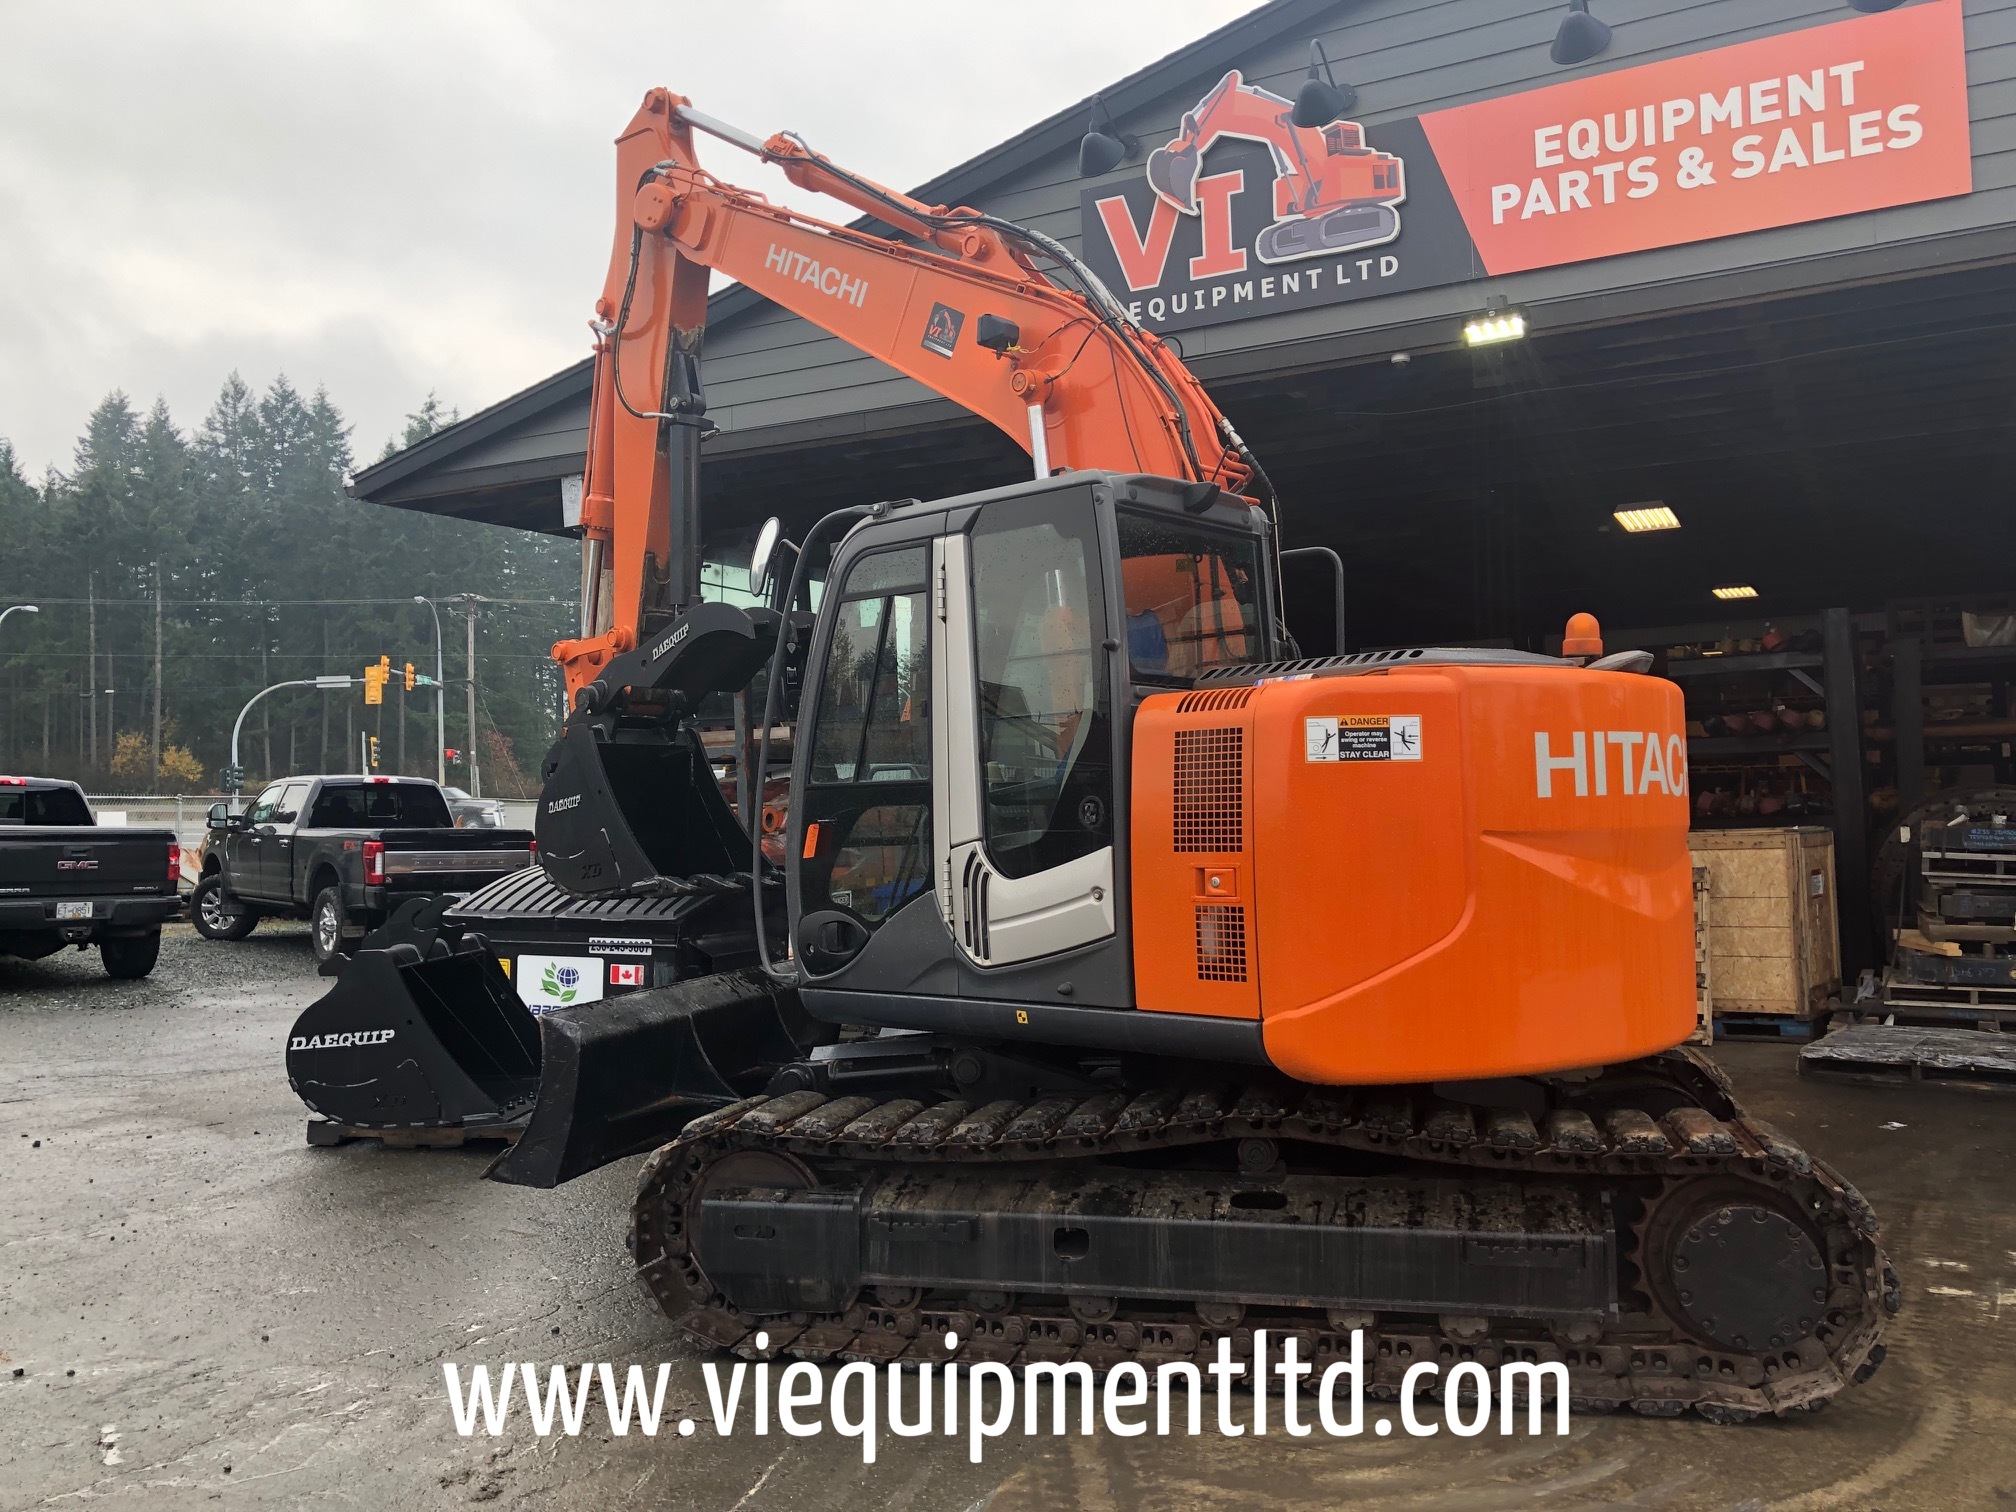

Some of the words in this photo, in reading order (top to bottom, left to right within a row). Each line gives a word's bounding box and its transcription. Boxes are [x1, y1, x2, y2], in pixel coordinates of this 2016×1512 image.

[1534, 60, 1865, 168] EQUIPMENT
[1491, 156, 1660, 226] PARTS
[1676, 146, 1718, 189] &
[1731, 103, 1923, 180] SALES
[1095, 169, 1248, 292] VI
[764, 243, 869, 308] HITACHI
[1129, 268, 1323, 321] EQUIPMENT
[1336, 255, 1400, 285] LTD
[652, 622, 690, 661] DAEQUIP
[1350, 717, 1389, 726] DANGER
[1340, 751, 1361, 759] STAY
[548, 793, 582, 814] DAEQUIP
[57, 860, 99, 870] GMC
[289, 1029, 396, 1051] DAEQUIP
